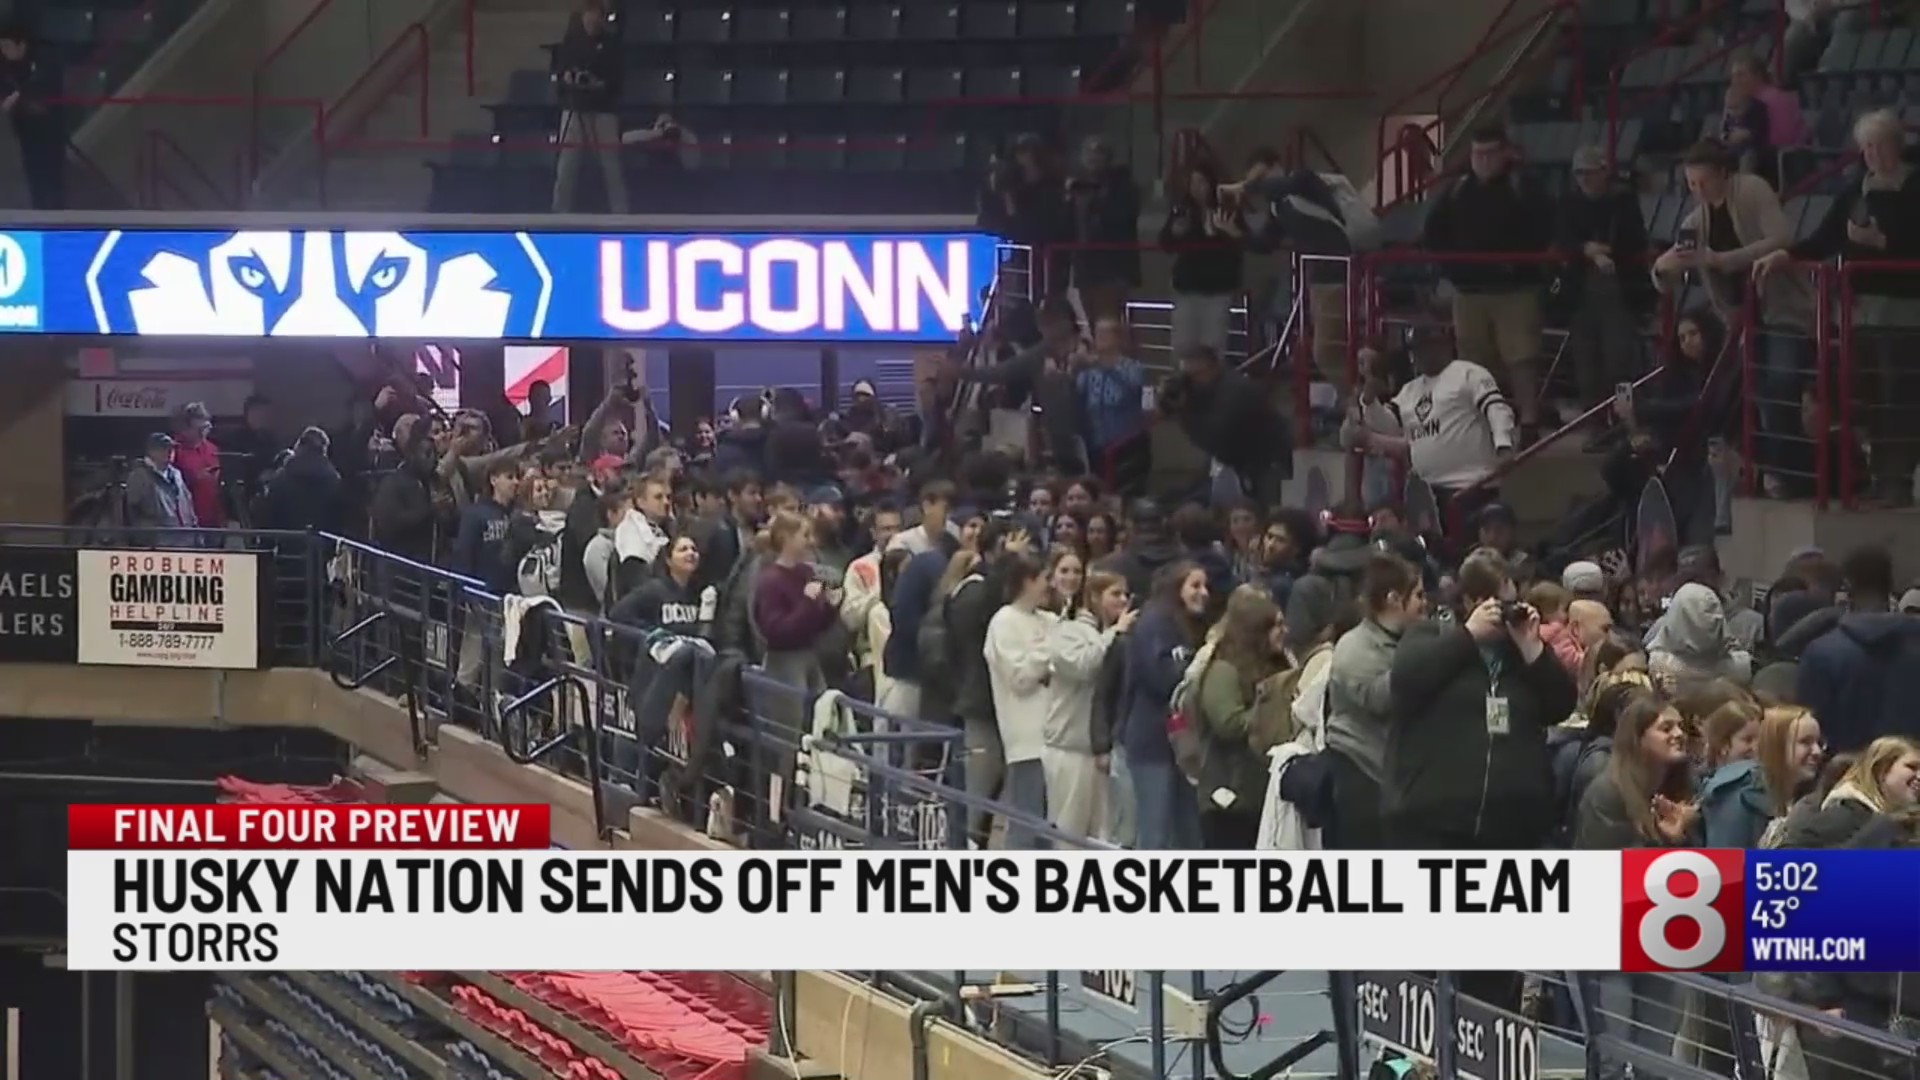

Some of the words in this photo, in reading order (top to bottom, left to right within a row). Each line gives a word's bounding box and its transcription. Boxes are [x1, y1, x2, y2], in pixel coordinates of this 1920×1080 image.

[601, 239, 969, 333] UCONN
[110, 556, 224, 575] PROBLEM
[110, 574, 224, 605] GAMBLING
[110, 605, 224, 622] HELPLINE
[119, 633, 215, 650] 1-888-789-7777
[1364, 981, 1390, 1023] SEC
[1399, 981, 1435, 1056] 110
[1458, 1016, 1485, 1061] SEC
[1495, 1018, 1536, 1080] 110
